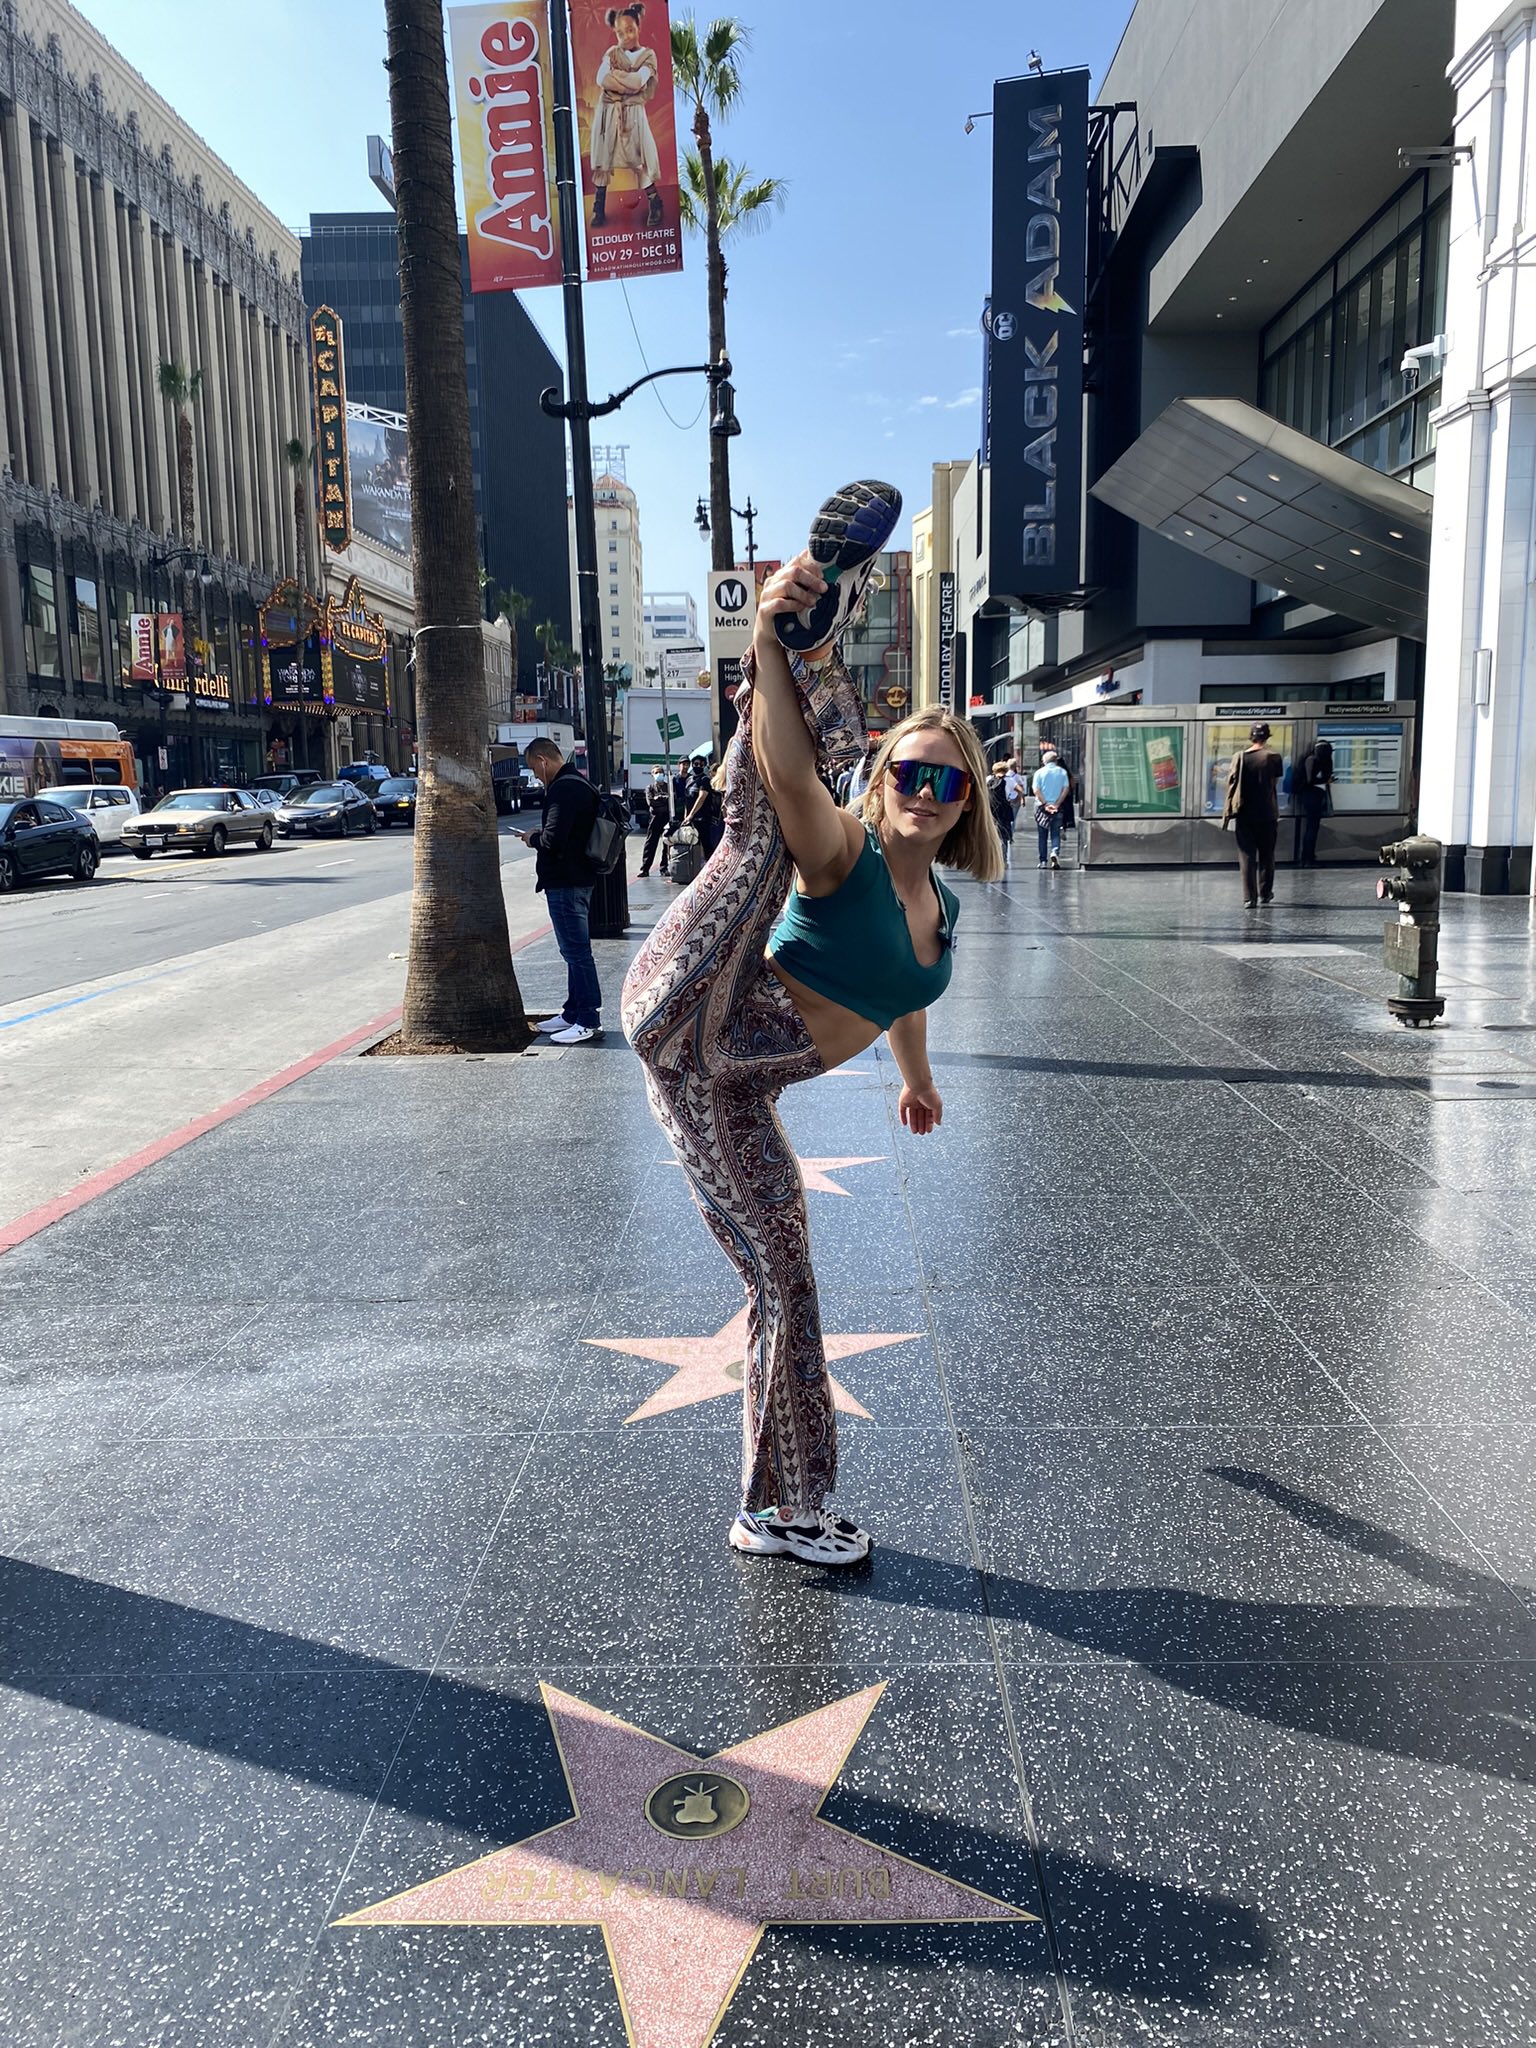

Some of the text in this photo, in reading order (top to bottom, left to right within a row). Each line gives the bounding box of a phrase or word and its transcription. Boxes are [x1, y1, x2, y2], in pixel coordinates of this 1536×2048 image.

[469, 18, 553, 260] Annie
[605, 228, 675, 244] DOLBY THEATRE
[592, 250, 616, 264] NOV
[620, 248, 633, 260] 29
[641, 245, 662, 258] DEC
[665, 243, 677, 255] 18
[314, 325, 336, 346] EL
[1023, 103, 1070, 567] BLACK ADAM
[317, 350, 344, 529] CAPITAN
[361, 483, 403, 500] WAKANDA
[720, 584, 742, 607] M
[715, 616, 749, 627] Metro
[941, 580, 953, 689] DOLBY THEATRE
[135, 618, 154, 674] Annie
[479, 1866, 894, 1900] BURT LANCASTER
